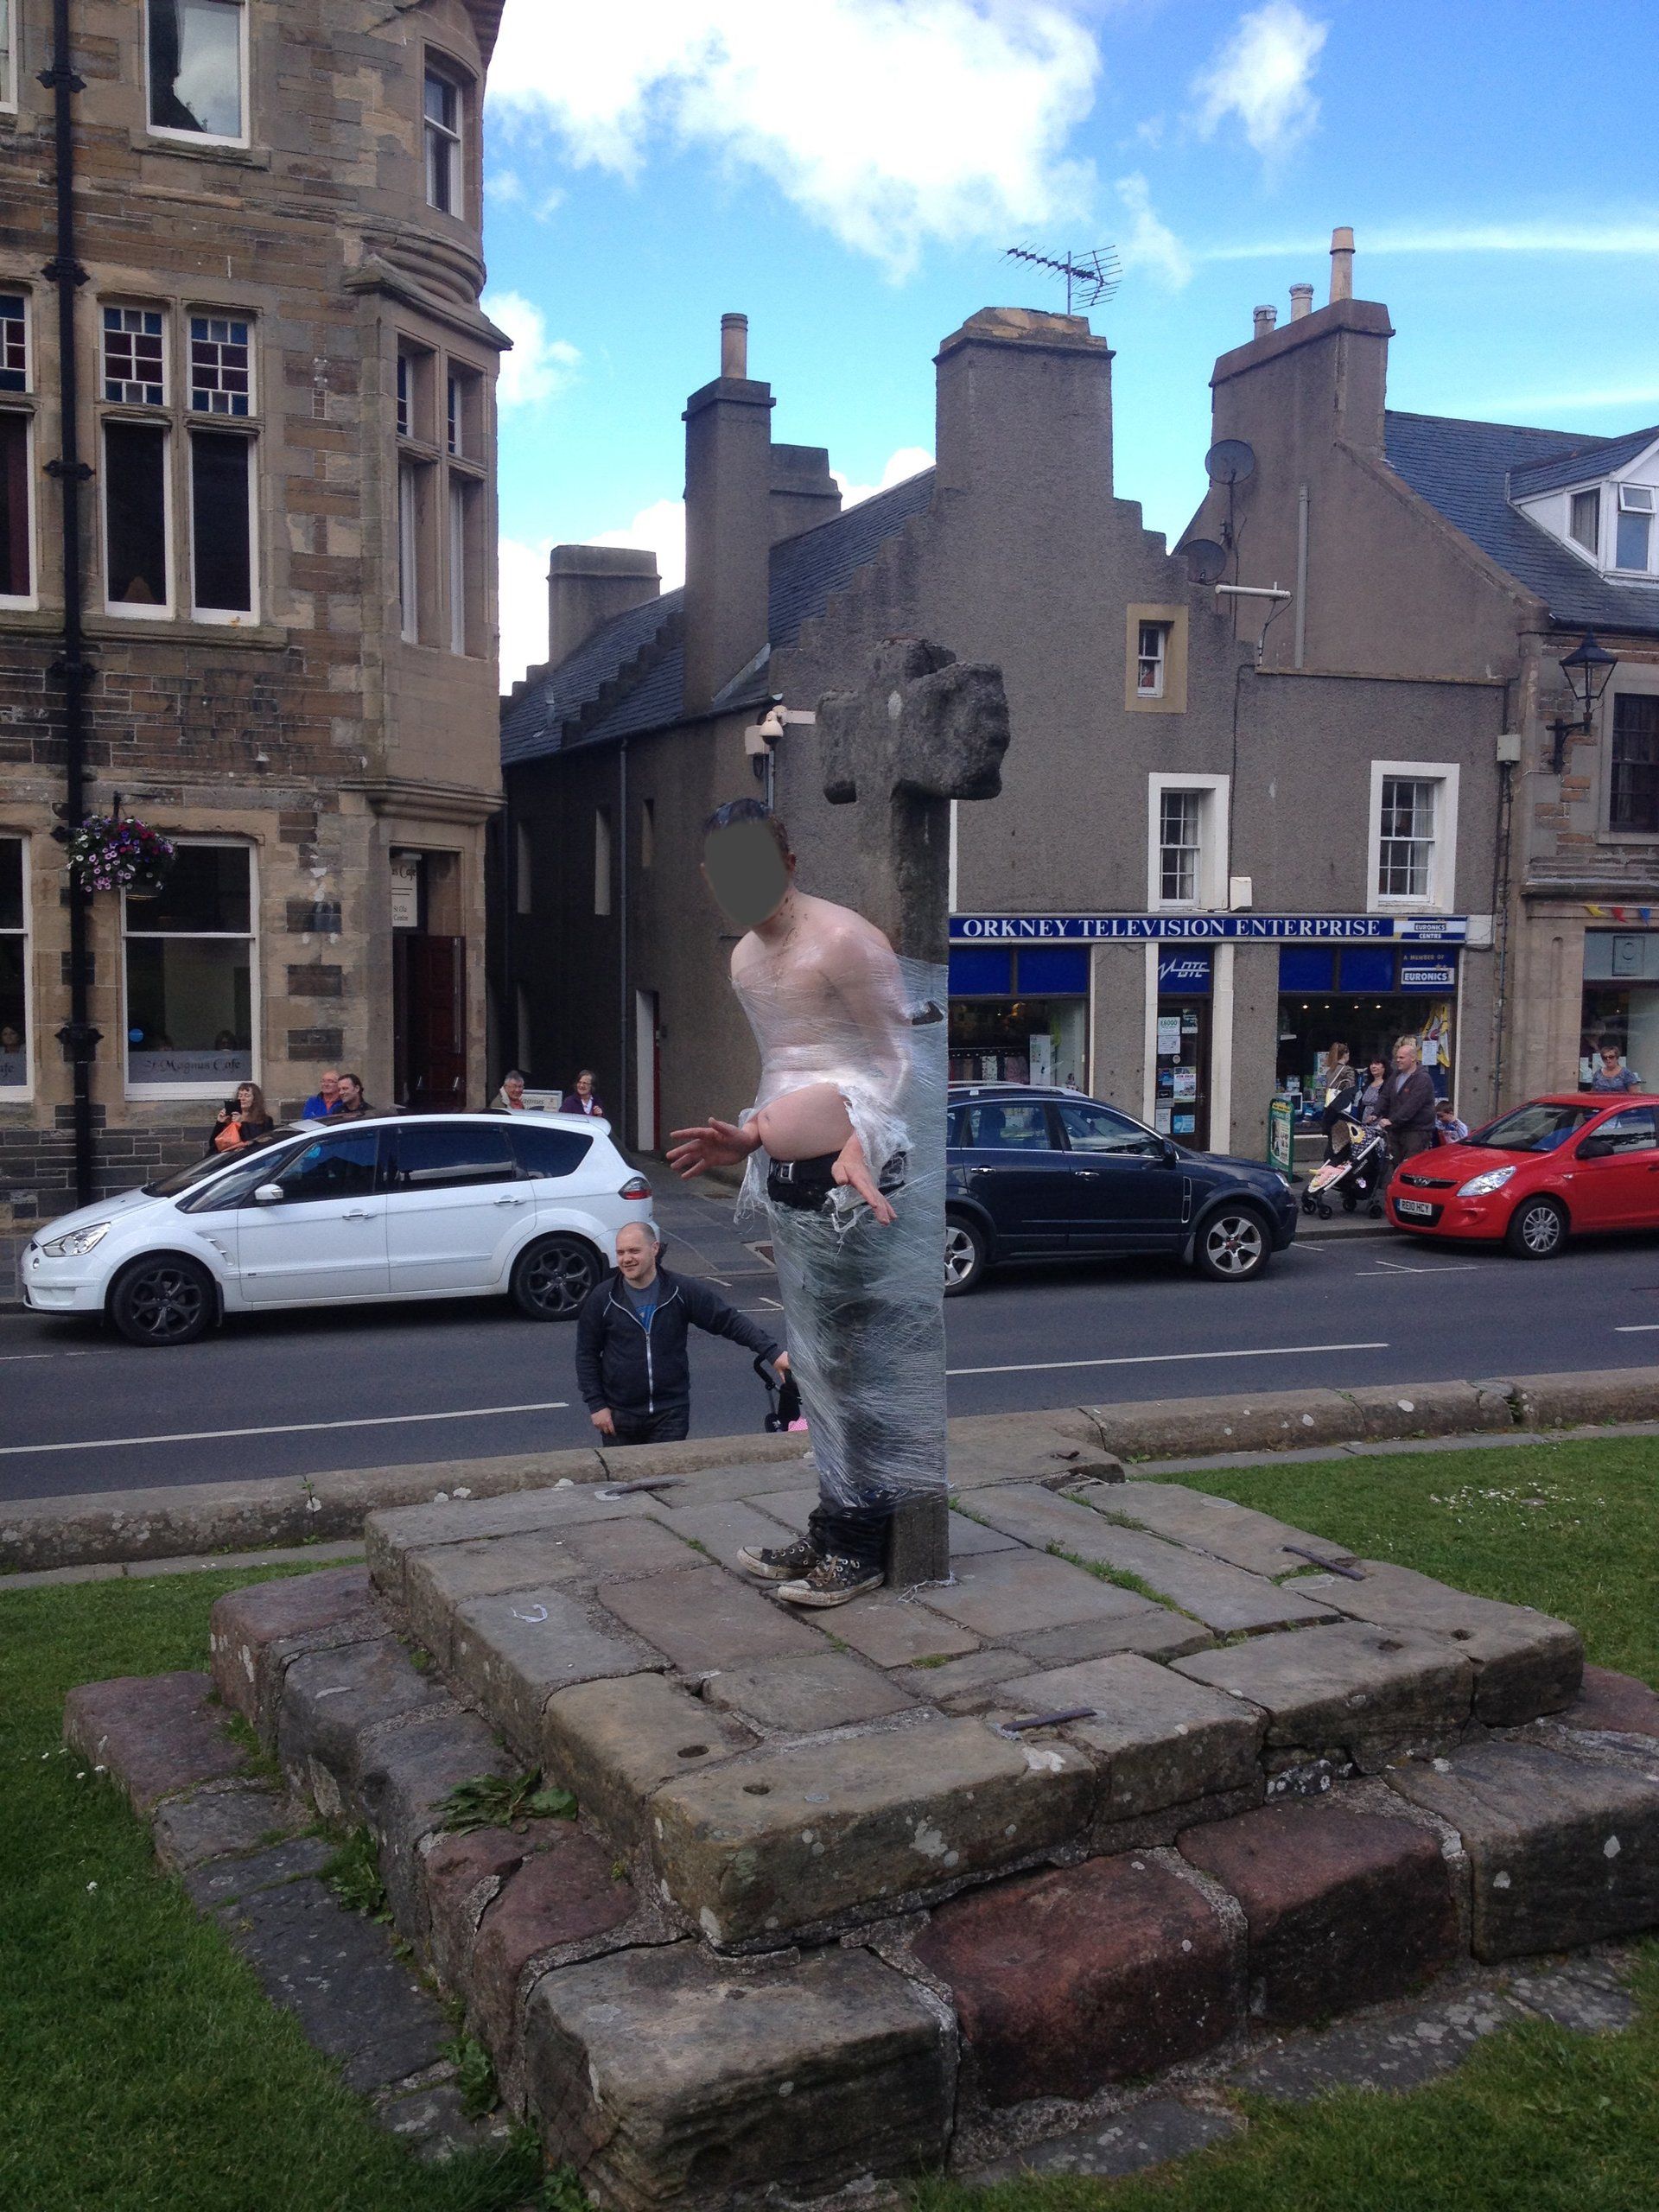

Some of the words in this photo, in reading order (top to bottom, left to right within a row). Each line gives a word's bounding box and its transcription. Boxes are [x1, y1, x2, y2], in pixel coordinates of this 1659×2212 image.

[963, 918, 1070, 937] ORKNEY
[1078, 918, 1226, 937] TELEVISION
[1236, 919, 1380, 936] ENTERPRISE
[1404, 972, 1447, 981] EURONICS
[0, 1063, 15, 1077] afe
[213, 1058, 241, 1072] Cafe
